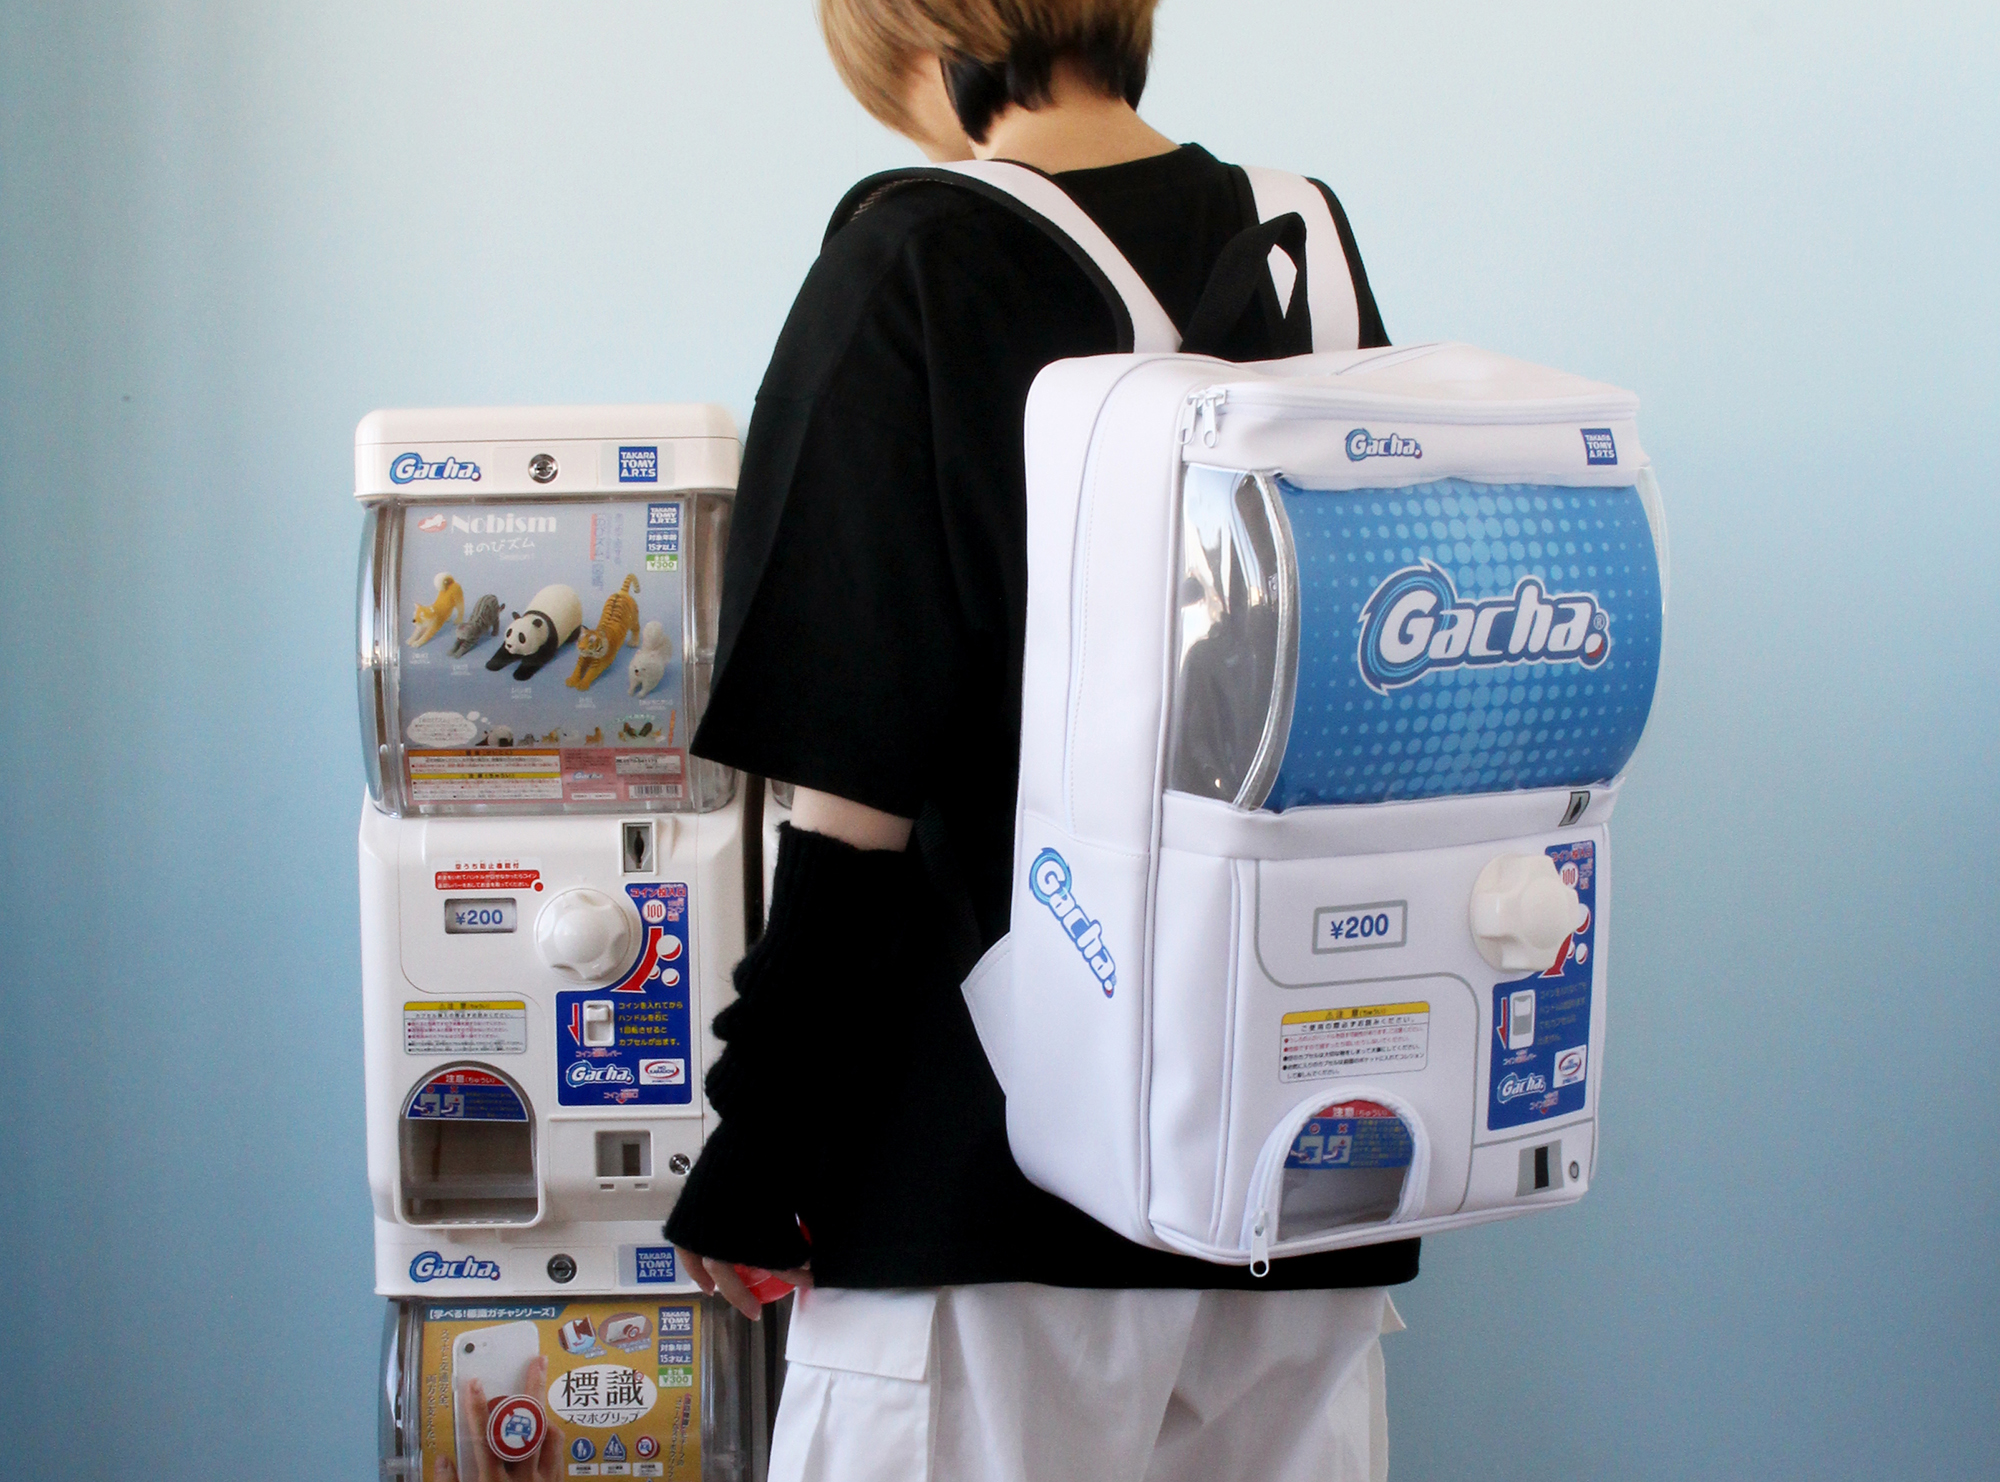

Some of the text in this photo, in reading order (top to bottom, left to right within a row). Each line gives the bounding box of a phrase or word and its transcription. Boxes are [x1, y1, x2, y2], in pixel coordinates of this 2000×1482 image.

[1584, 433, 1612, 442] TAKARA
[1586, 441, 1613, 450] TOMY
[620, 451, 656, 460] TAKARA
[621, 460, 656, 468] TOMY
[451, 513, 557, 534] Nobism
[648, 543, 677, 551] 15才以上
[650, 561, 675, 569] ¥300
[1562, 867, 1576, 886] 100
[630, 888, 687, 898] コイン投入口
[647, 904, 662, 918] 100
[455, 909, 503, 925] ¥200
[1330, 913, 1389, 940] ¥200
[638, 1252, 673, 1260] TAKARA
[638, 1260, 674, 1269] TOMY
[660, 1343, 691, 1352] 対象年齢
[660, 1354, 691, 1363] 15才以上
[663, 1376, 689, 1384] ¥300
[561, 1369, 643, 1407] 標識
[565, 1412, 639, 1424] スマホグリップ
